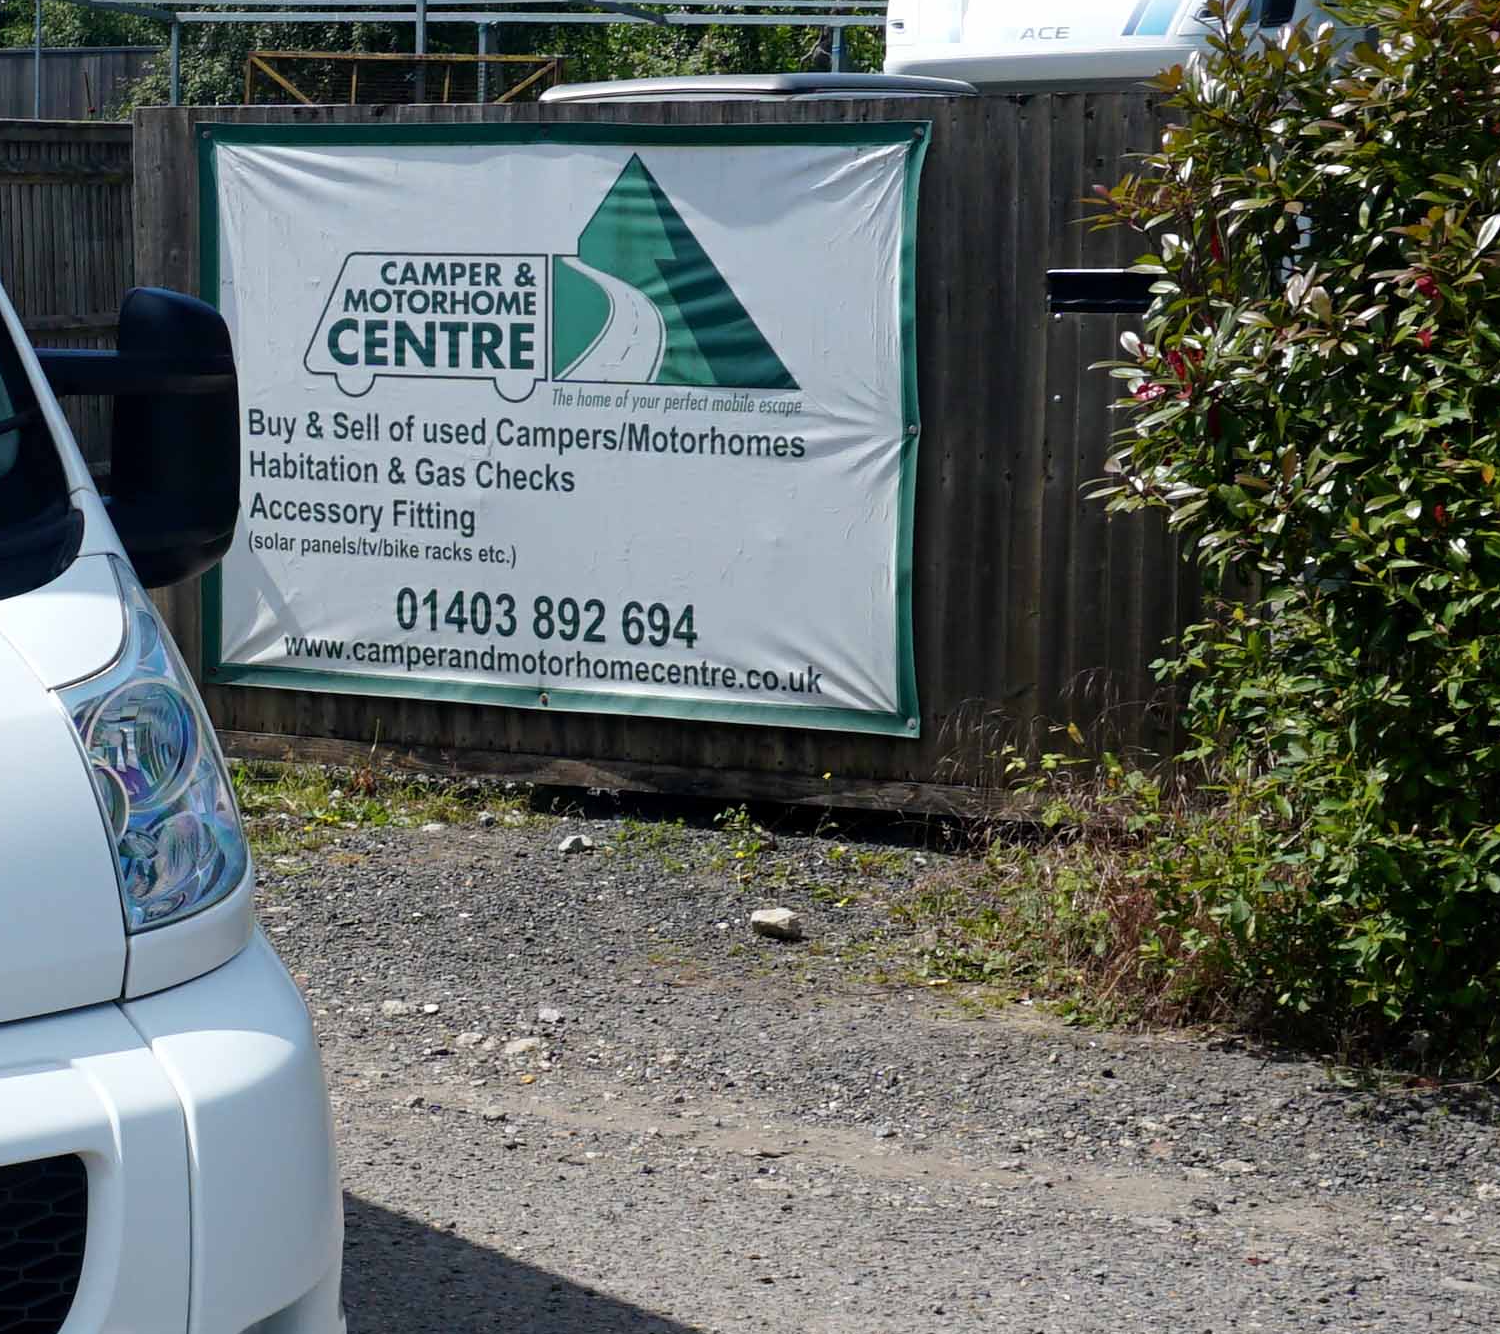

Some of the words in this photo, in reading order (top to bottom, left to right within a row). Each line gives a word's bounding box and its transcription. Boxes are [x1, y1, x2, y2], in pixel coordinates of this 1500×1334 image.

[1020, 26, 1070, 40] ACE
[380, 260, 503, 287] CAMPER
[514, 262, 537, 287] &
[343, 288, 537, 316] MOTORHOME
[327, 317, 536, 370] CENTRE
[552, 388, 574, 407] The
[576, 390, 612, 408] home
[615, 389, 631, 409] of
[631, 395, 661, 413] your
[663, 391, 709, 414] perfect
[711, 393, 755, 414] mobile
[759, 399, 803, 417] escape
[248, 408, 297, 444] Buy
[305, 410, 324, 440] &
[332, 412, 380, 442] Sell
[388, 414, 416, 443] of
[422, 417, 487, 446] used
[496, 417, 806, 459] Campers/Motorhomes
[249, 450, 379, 484] Habitation
[387, 456, 406, 485] &
[415, 457, 466, 488] Gas
[475, 460, 576, 493] Checks
[249, 491, 384, 533] Accessory
[392, 499, 476, 539] Fitting
[248, 530, 297, 554] (solar
[301, 537, 420, 560] panels/tv/bike
[425, 543, 473, 562] racks
[478, 545, 518, 569] etc.)
[395, 585, 517, 637] 01403
[532, 594, 607, 644] 892
[620, 600, 699, 650] 694
[284, 633, 824, 695] www.camperandmotorhomecentre.co.uk
